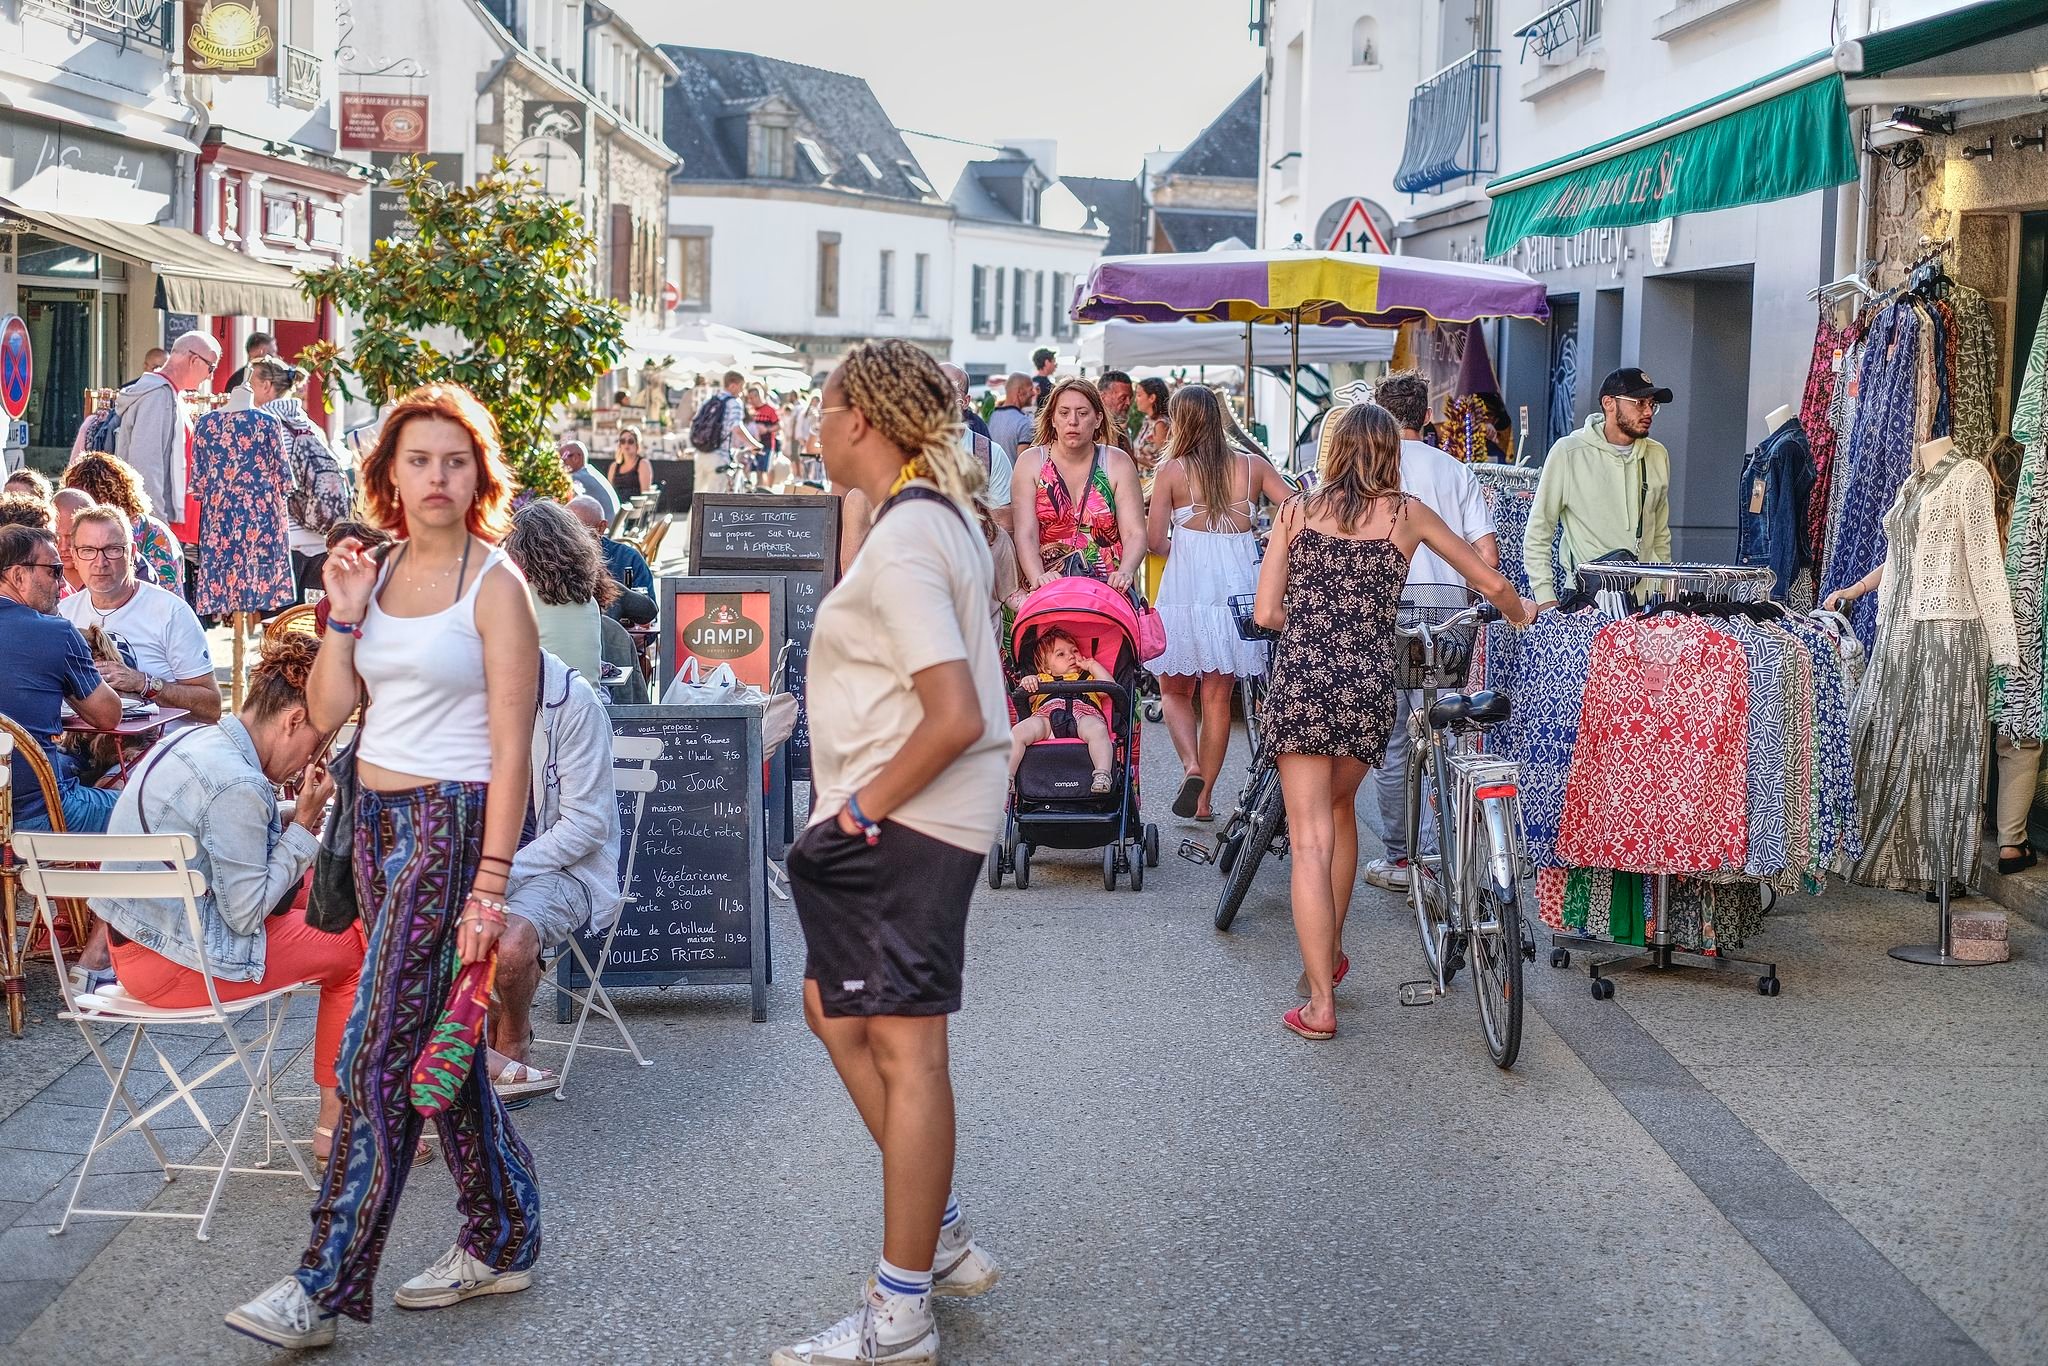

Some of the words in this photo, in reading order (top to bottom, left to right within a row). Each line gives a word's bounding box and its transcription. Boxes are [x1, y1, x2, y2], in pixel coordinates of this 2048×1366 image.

[196, 39, 266, 57] GRIMBERGEN
[344, 96, 388, 106] BOUCHERIE
[1628, 168, 1653, 203] LE
[712, 511, 724, 522] LA
[761, 512, 798, 521] TROTTE
[726, 531, 755, 542] propose
[767, 529, 784, 538] SUR
[787, 529, 811, 539] PLACE
[753, 542, 795, 552] EMPORTER
[796, 583, 814, 596] 11,90
[796, 604, 814, 614] 16,90
[692, 628, 753, 645] JAMPI
[701, 733, 730, 744] Pommes
[688, 749, 714, 760] l'huile
[722, 750, 741, 760] 7,50
[659, 779, 676, 792] DU
[682, 771, 728, 791] JOUR
[651, 803, 685, 813] maison
[714, 802, 742, 819] 11,40
[647, 822, 664, 836] de
[667, 818, 711, 838] Poulet
[642, 840, 683, 855] Frites
[653, 865, 732, 887] Végétarienne
[678, 885, 714, 897] Salade
[636, 899, 662, 913] verte
[718, 897, 745, 914] 11,90
[648, 923, 660, 936] de
[668, 921, 717, 935] Cabillaud
[687, 935, 716, 944] maison
[724, 933, 747, 944] 13,90
